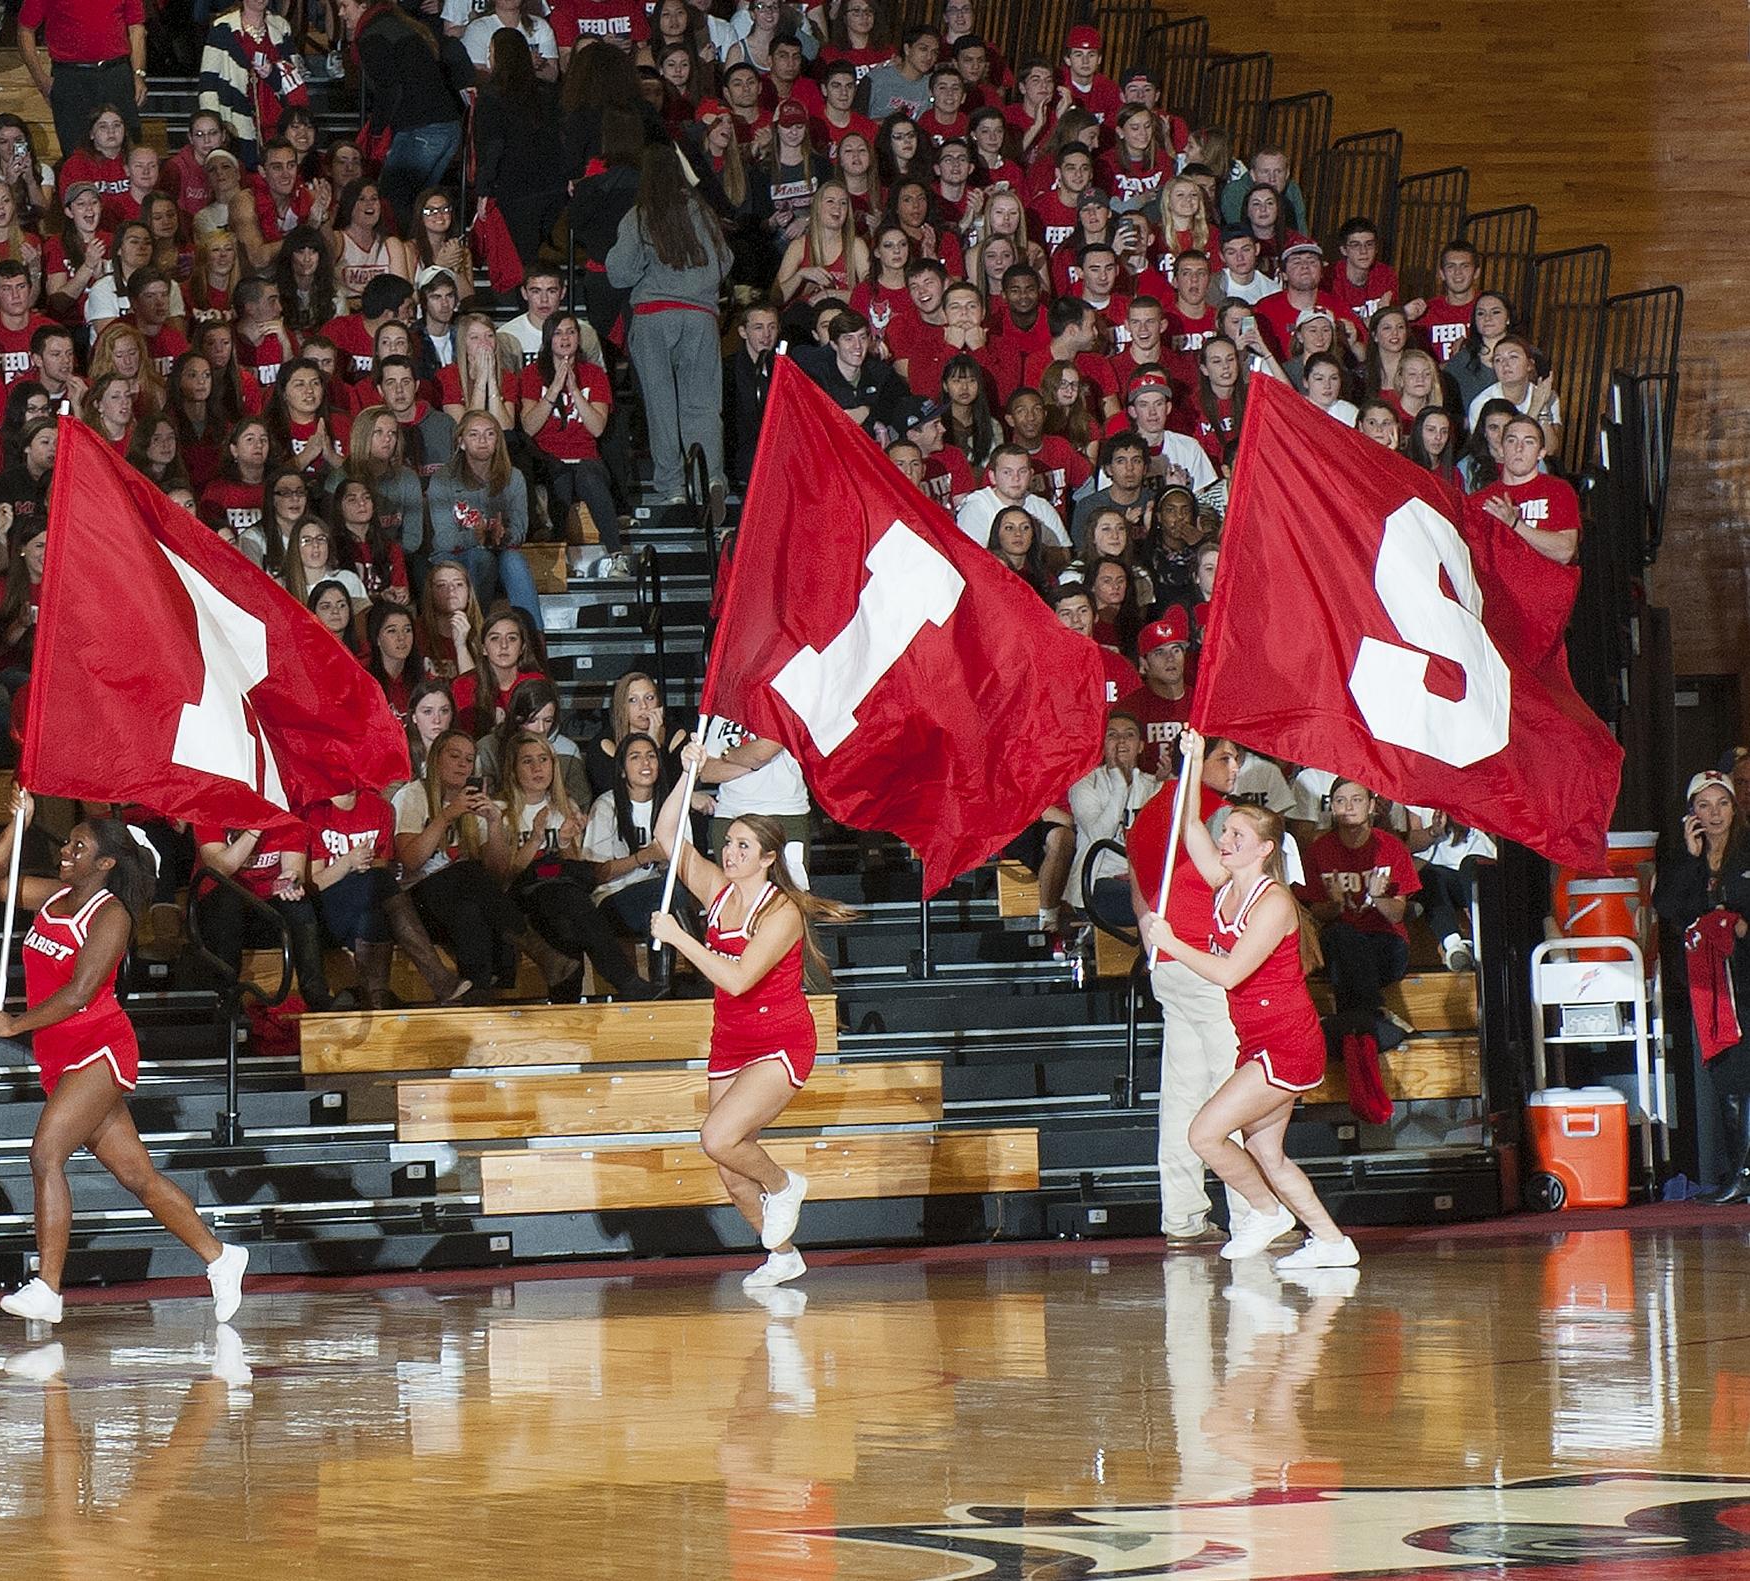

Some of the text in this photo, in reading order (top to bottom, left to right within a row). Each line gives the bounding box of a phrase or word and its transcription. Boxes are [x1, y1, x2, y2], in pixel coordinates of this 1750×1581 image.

[578, 16, 632, 36] FEED THE
[1432, 323, 1467, 343] FEED
[226, 507, 263, 530] FEED
[1518, 498, 1549, 520] THE
[771, 519, 966, 757] I
[1349, 496, 1511, 768] S
[322, 829, 349, 856] FEED
